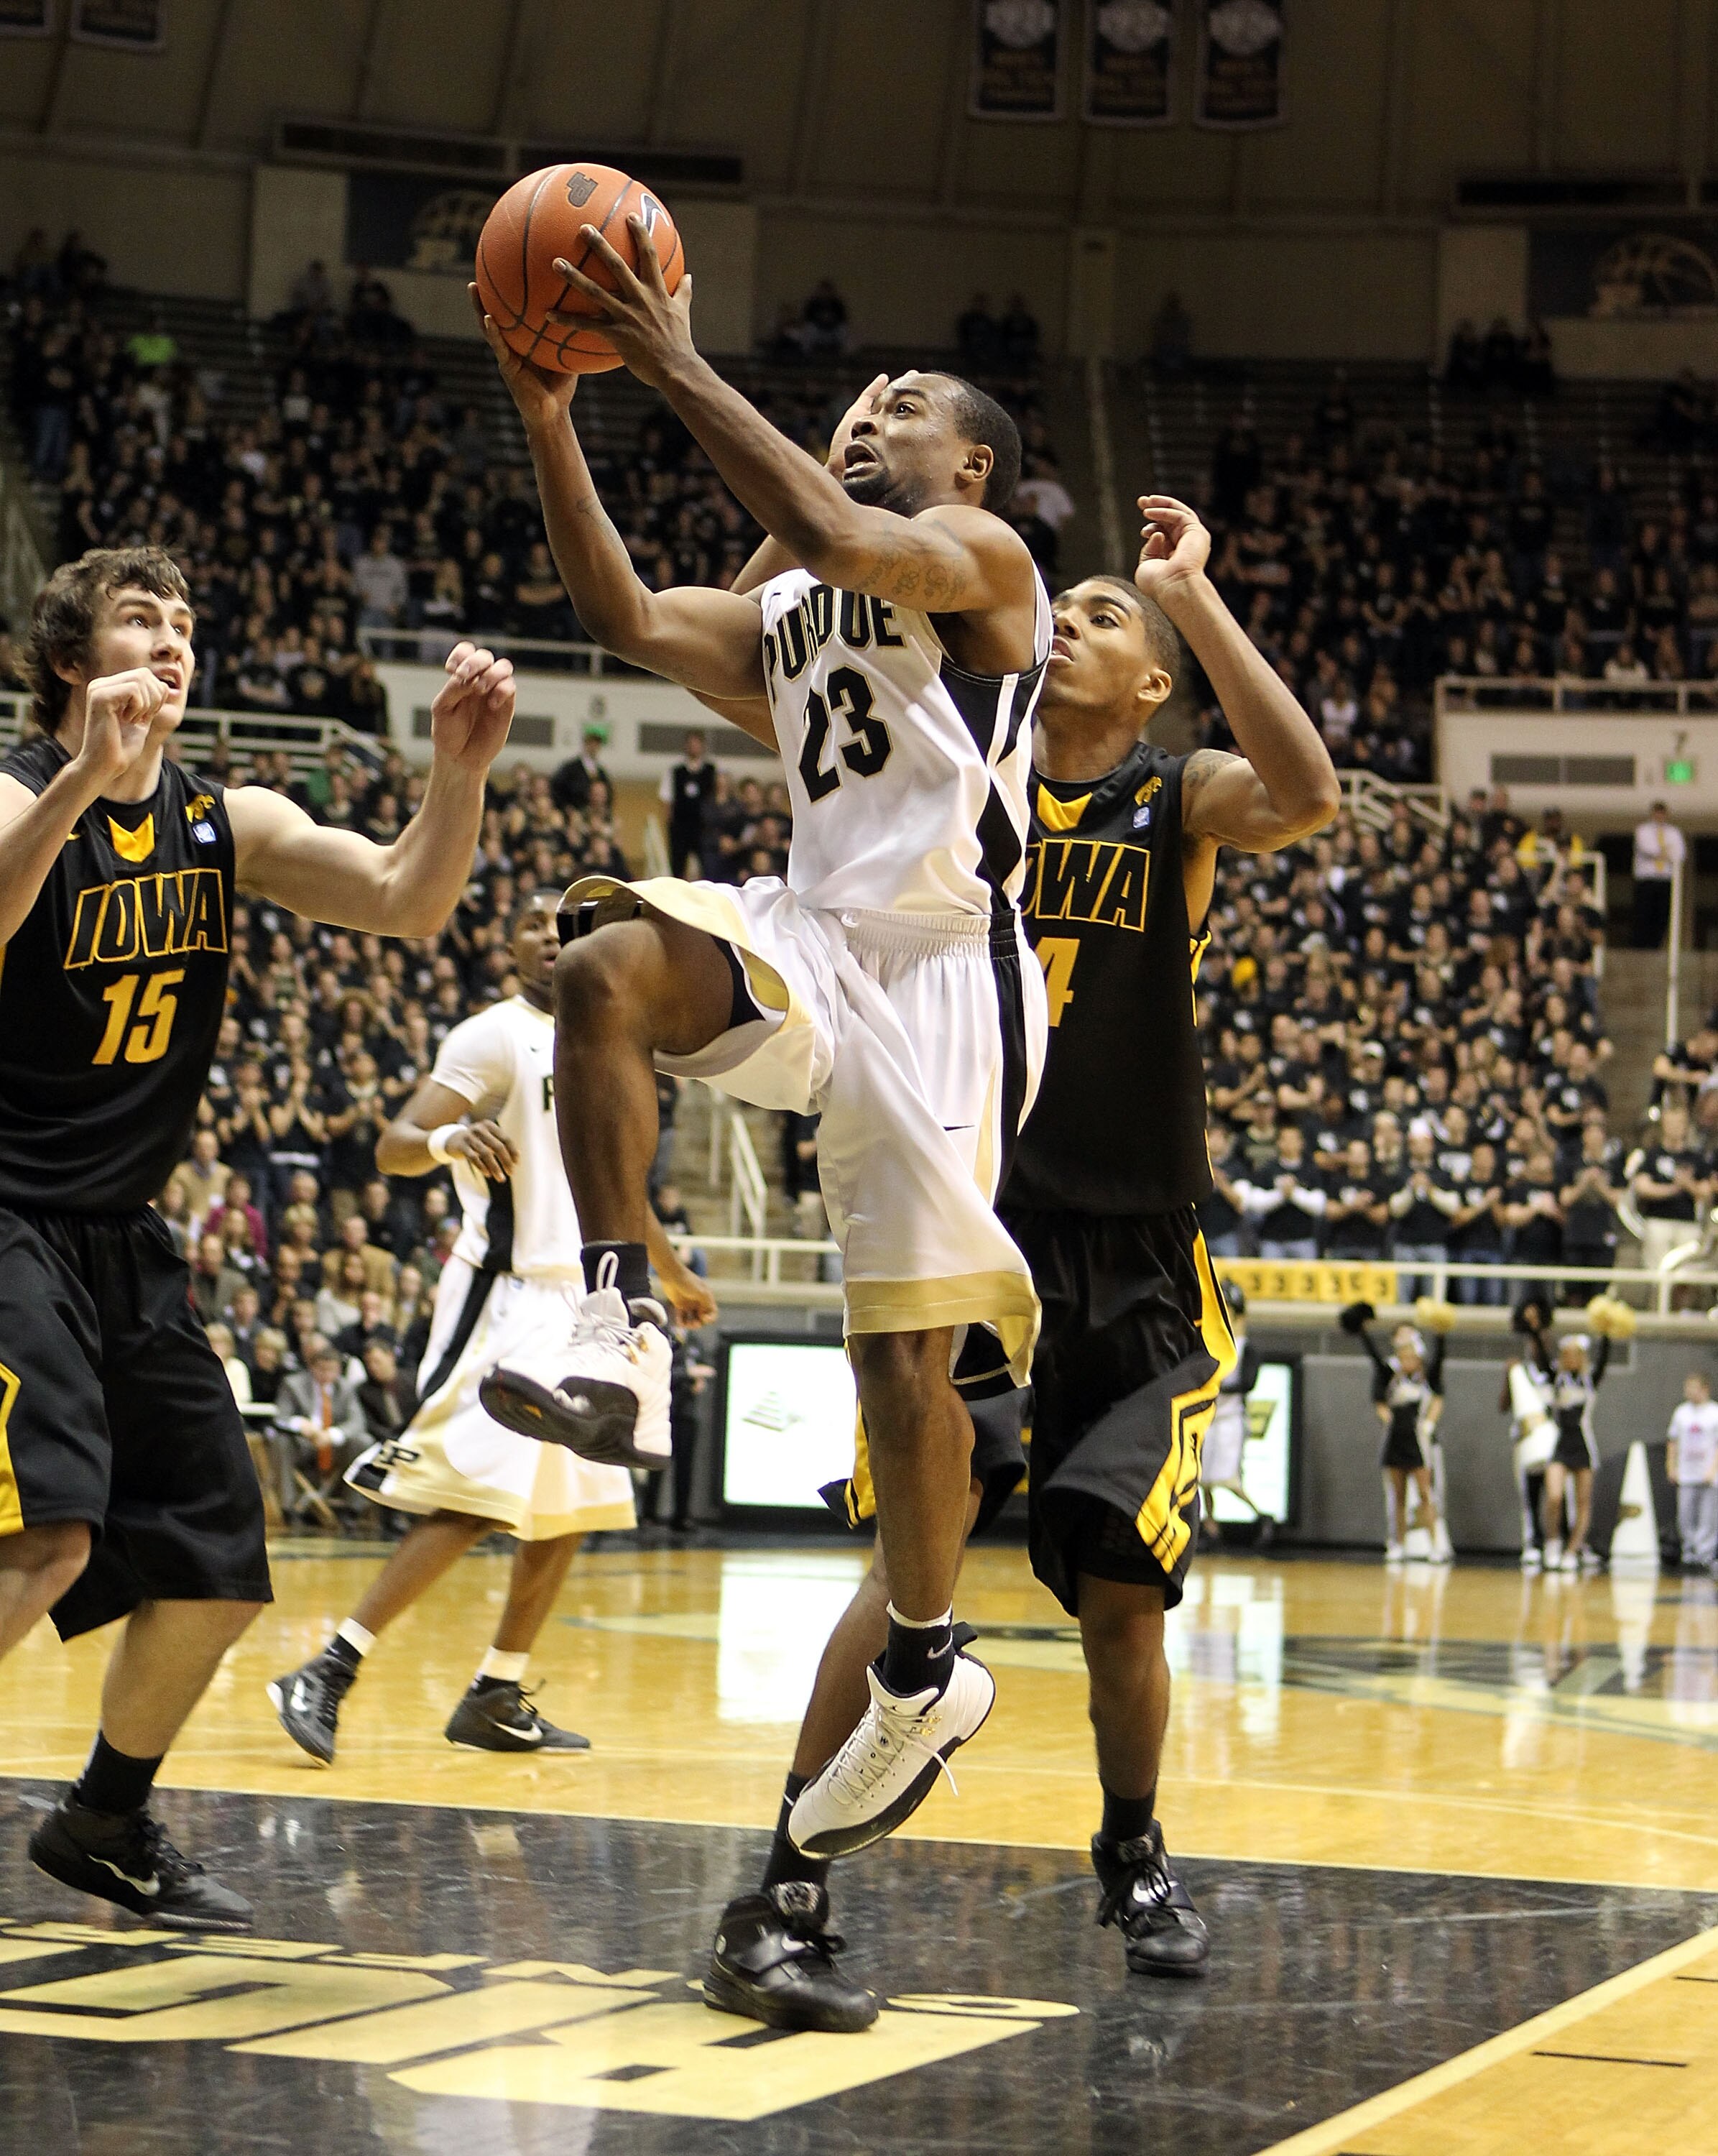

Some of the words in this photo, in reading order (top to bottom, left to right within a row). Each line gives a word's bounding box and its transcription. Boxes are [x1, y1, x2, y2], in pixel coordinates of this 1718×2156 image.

[798, 664, 894, 804] 23
[63, 867, 228, 970] IOWA
[91, 968, 186, 1065] 15
